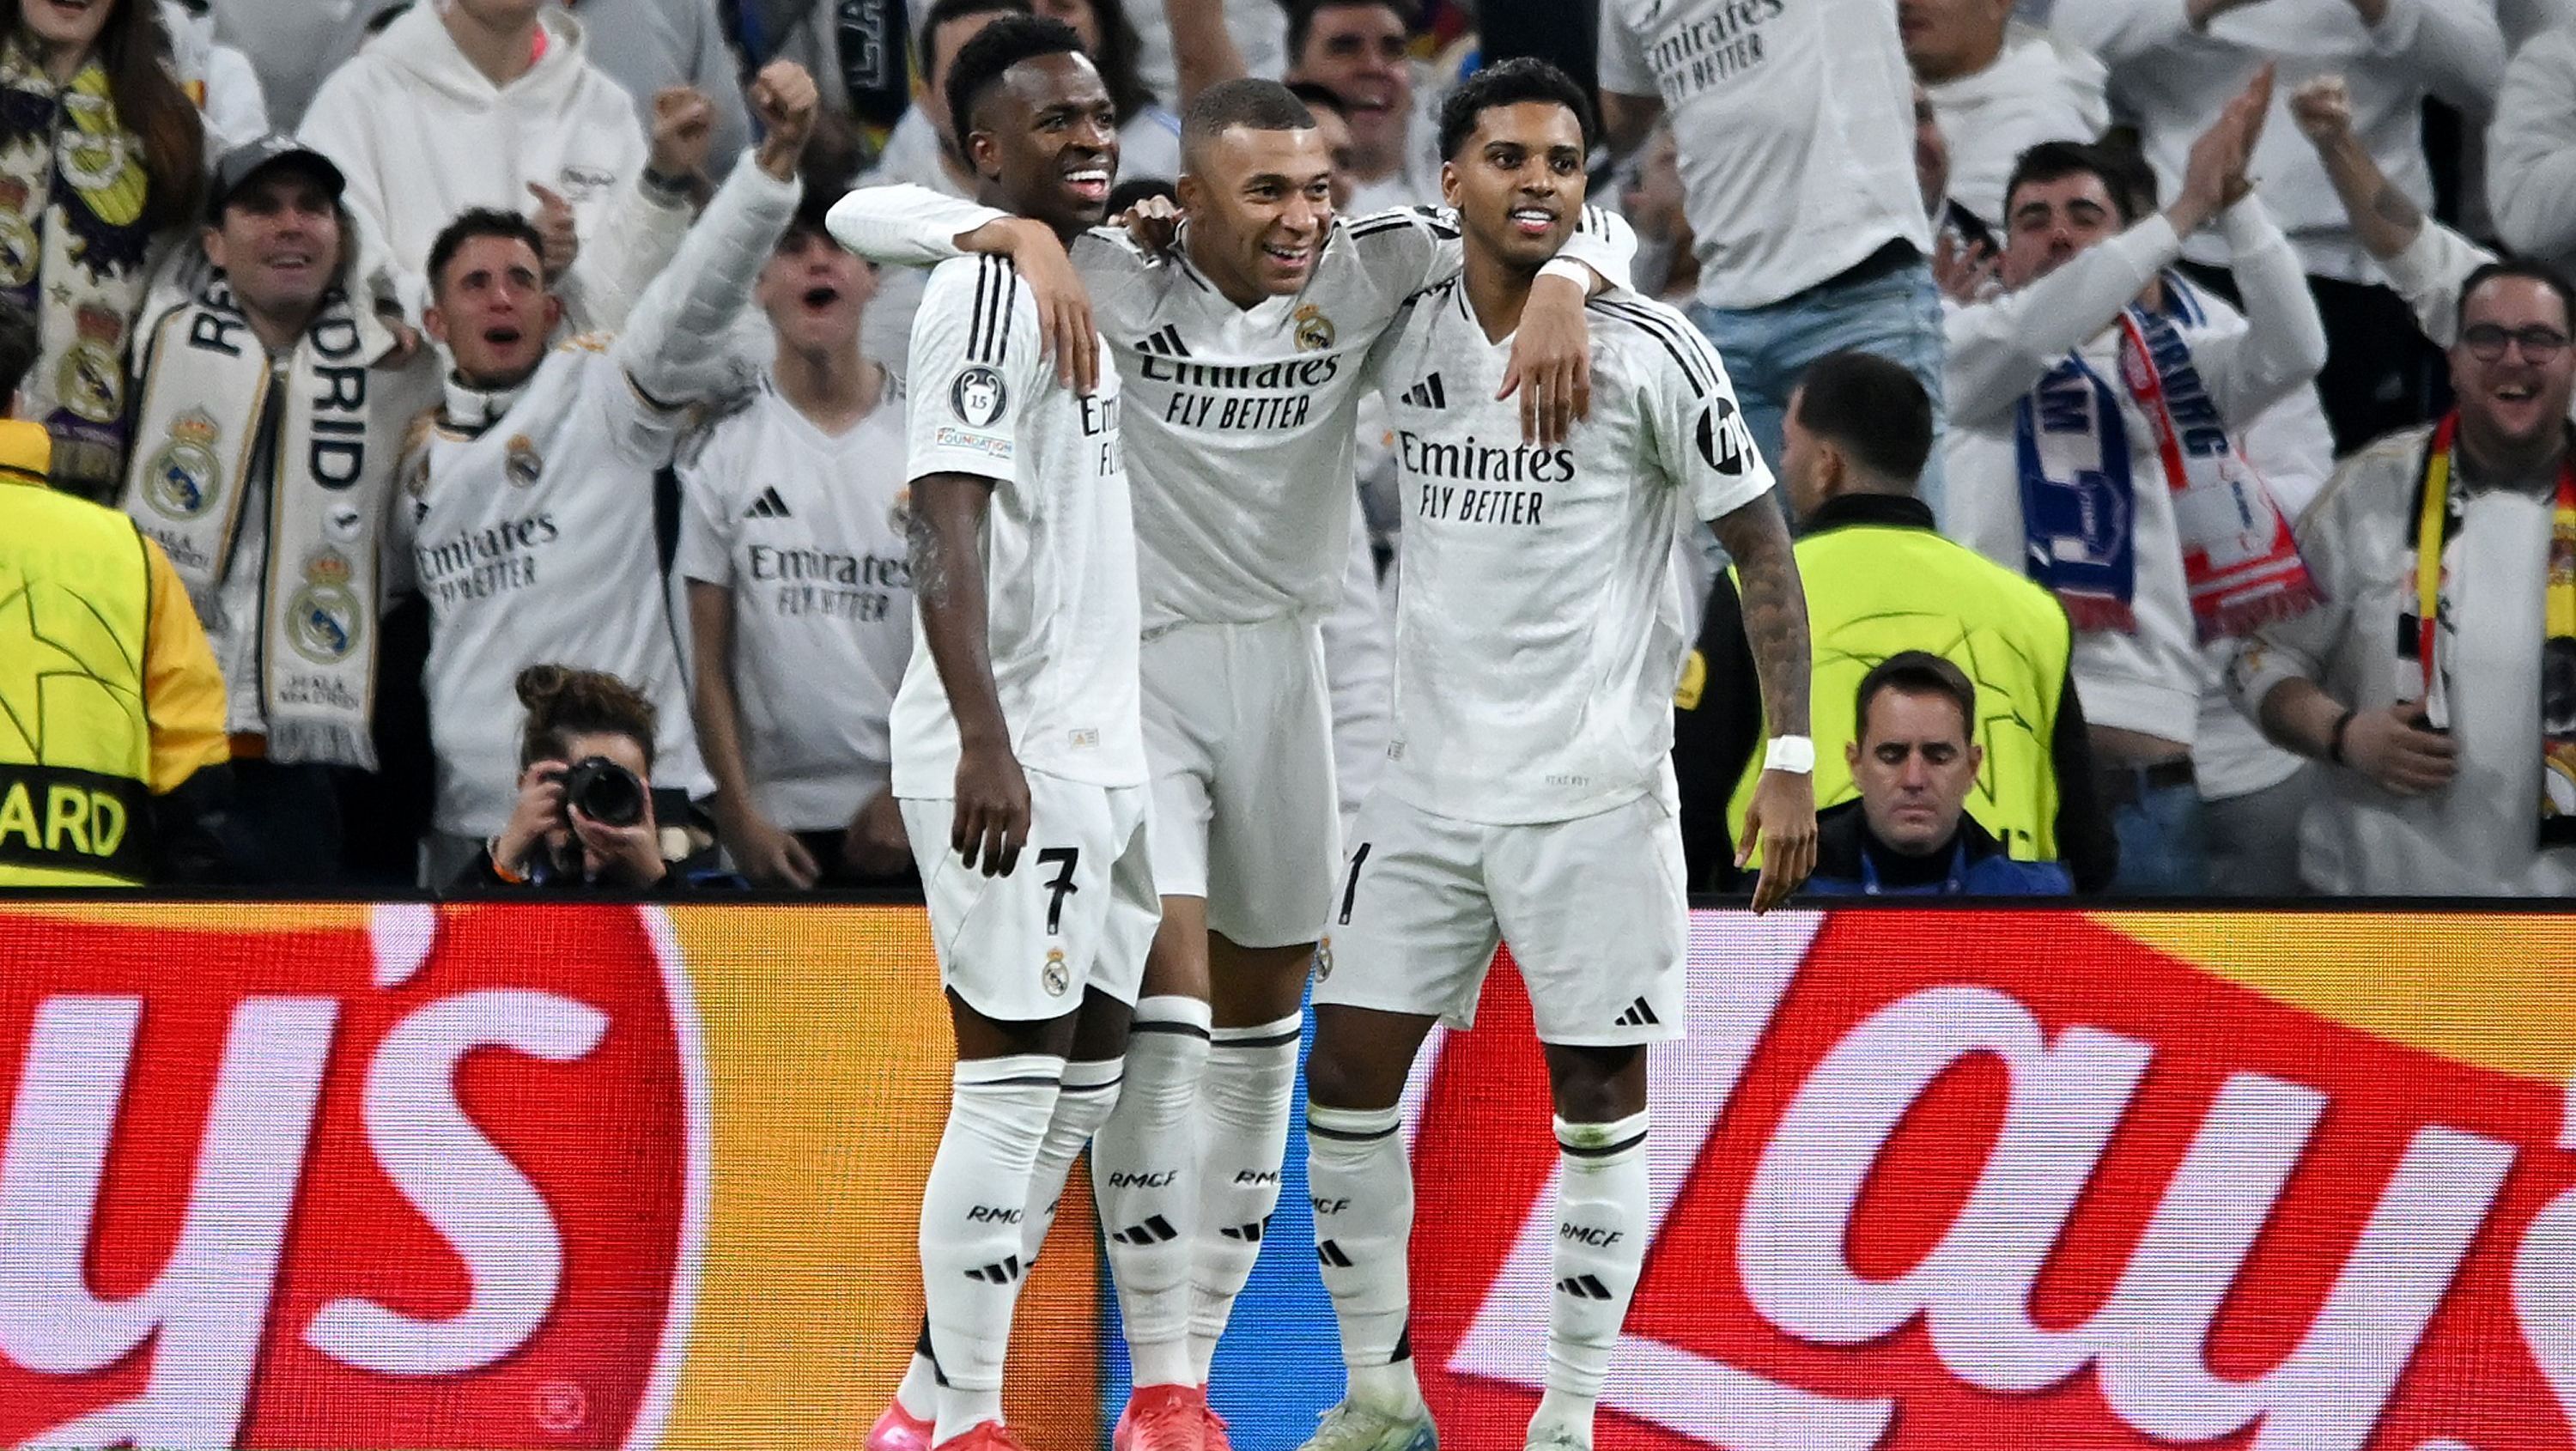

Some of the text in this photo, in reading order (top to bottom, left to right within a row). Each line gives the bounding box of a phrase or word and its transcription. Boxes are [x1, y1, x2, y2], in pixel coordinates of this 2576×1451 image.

[971, 394, 987, 410] 15
[1165, 392, 1310, 429] FLY BETTER
[1399, 430, 1576, 483] Emirates
[1419, 483, 1543, 525] FLY BETTER
[749, 543, 914, 589] Emirates
[0, 782, 127, 857] ARD
[1036, 847, 1078, 936] 7
[1109, 1169, 1179, 1188] RMCF
[1233, 1169, 1281, 1186] RM
[1447, 907, 2576, 1451] Lay
[966, 1205, 1024, 1224] RMC
[1559, 1223, 1624, 1248] RMCF
